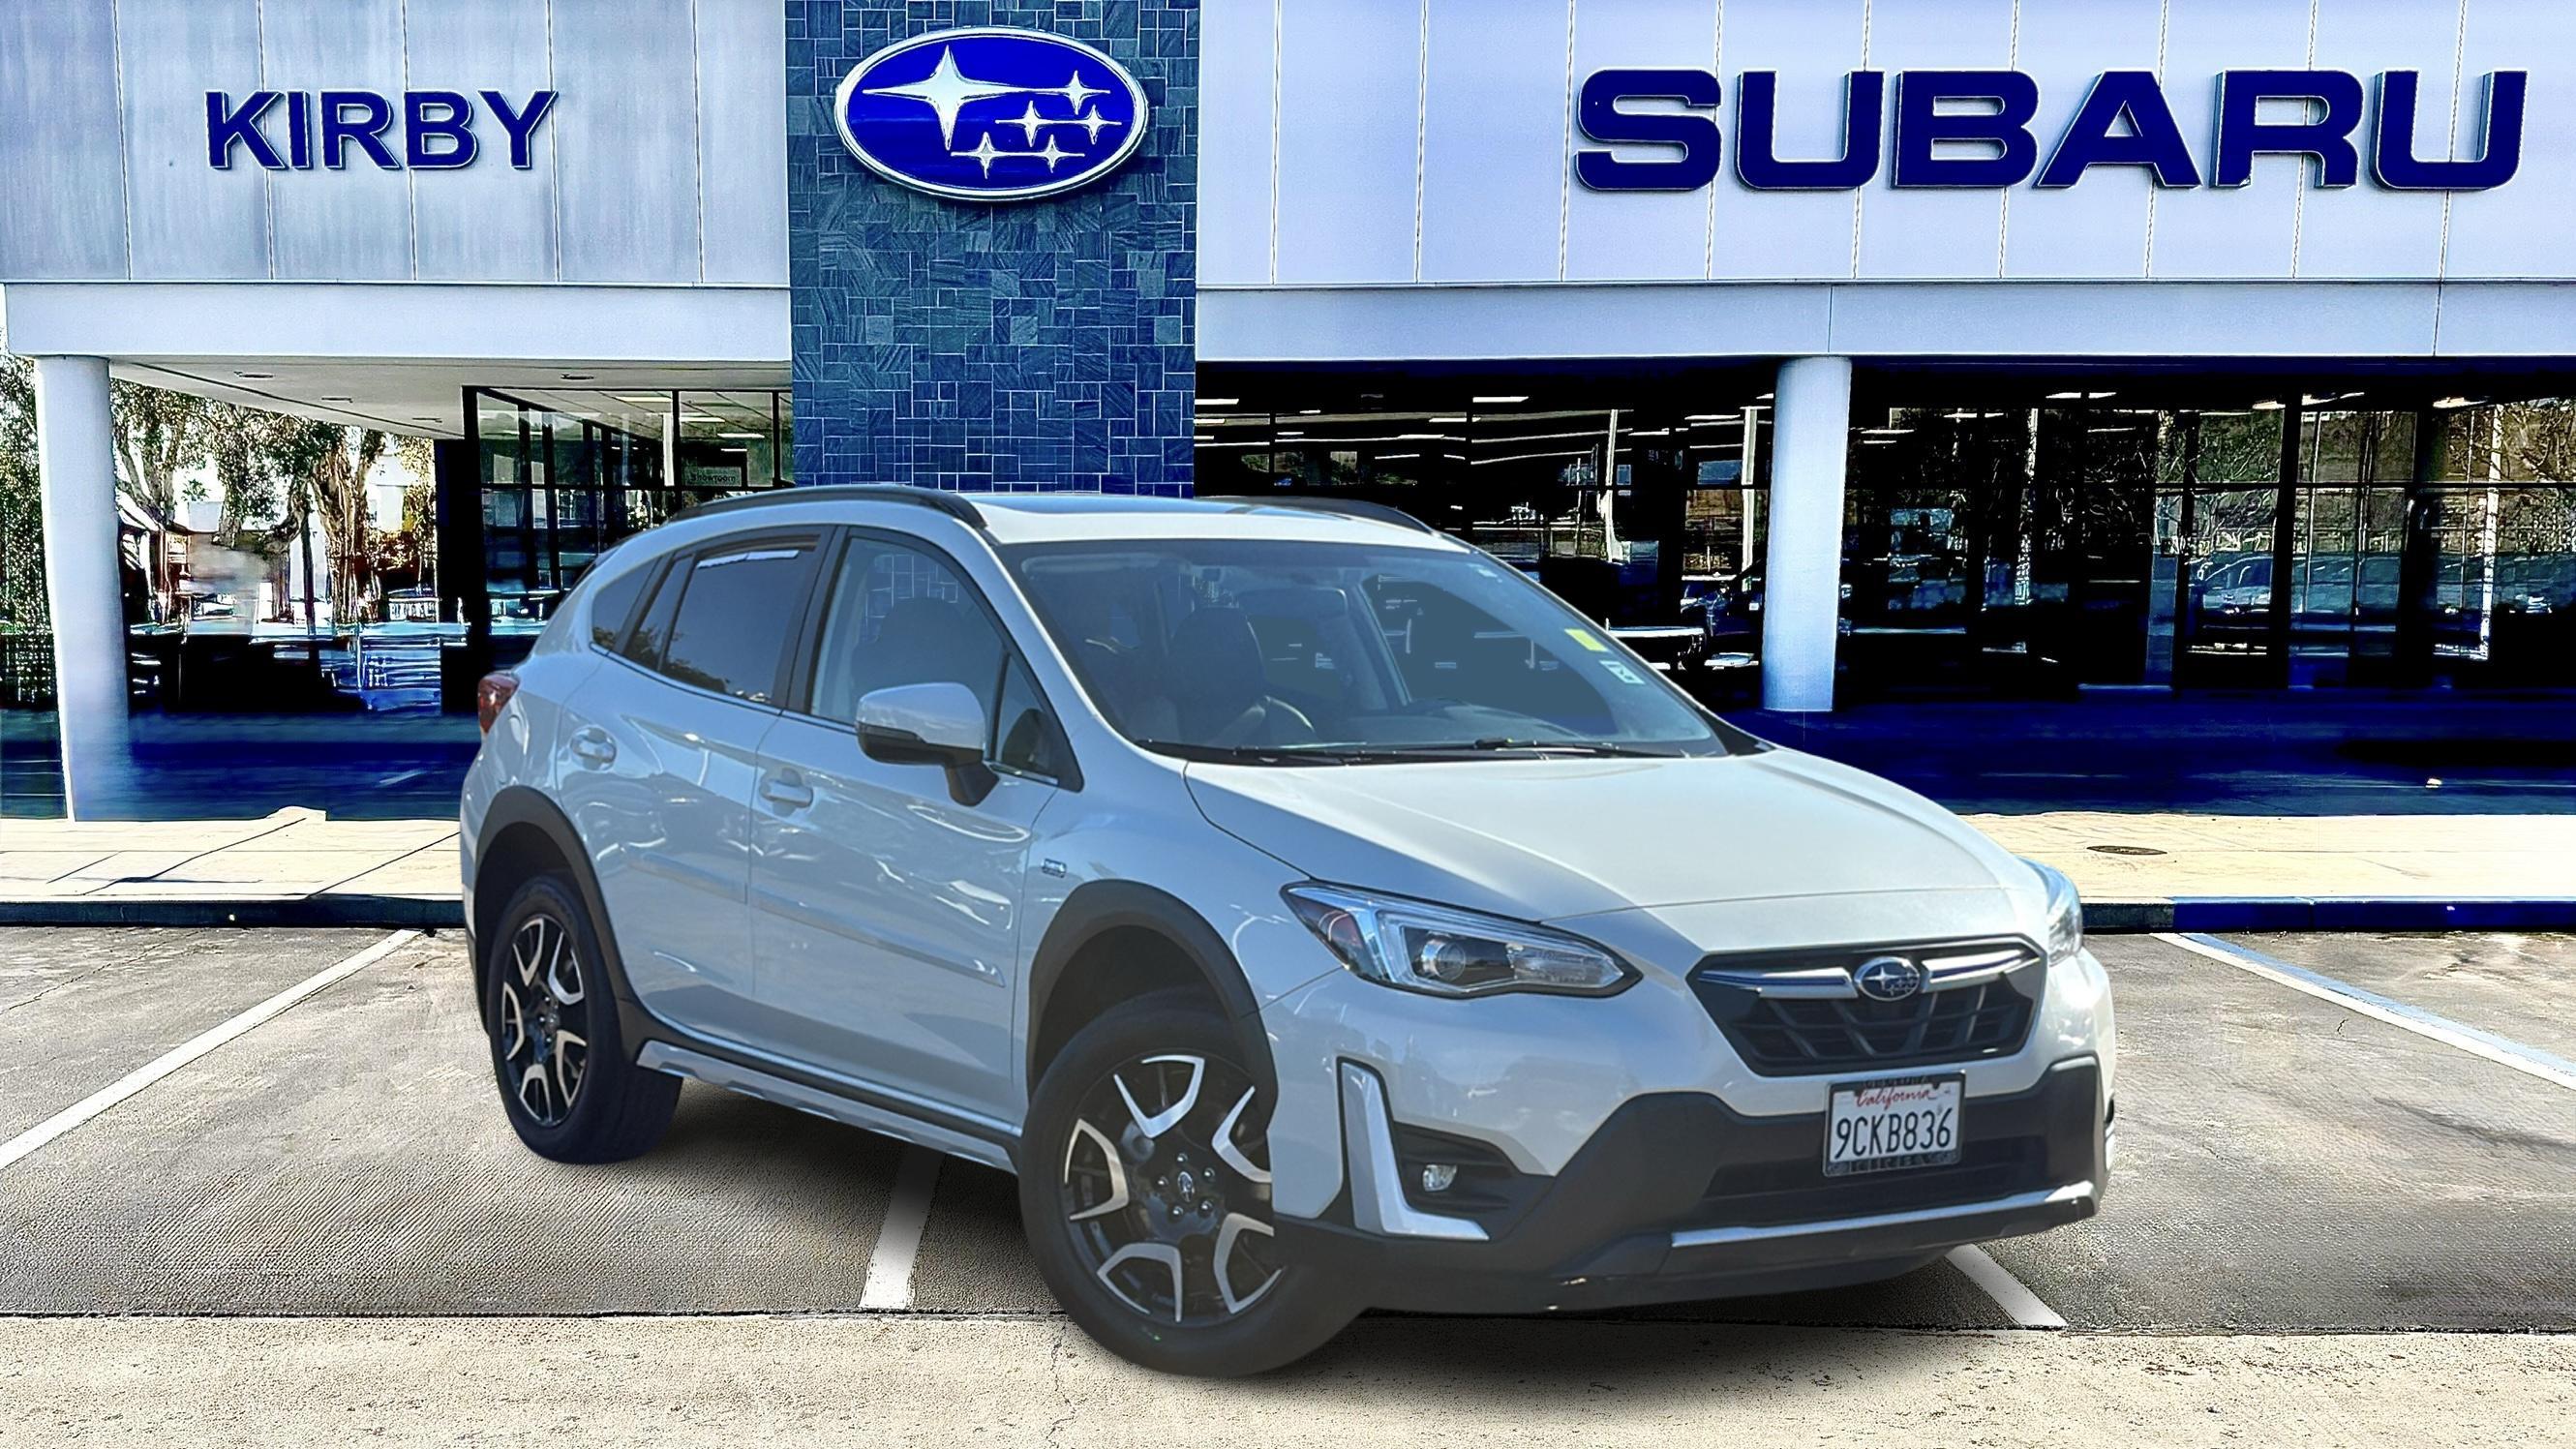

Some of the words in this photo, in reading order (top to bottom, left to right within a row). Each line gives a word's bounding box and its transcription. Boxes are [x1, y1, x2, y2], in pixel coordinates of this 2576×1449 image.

[206, 91, 559, 171] KIRBY
[1575, 70, 2526, 193] SUBARU
[1856, 1087, 1935, 1110] California
[1834, 1107, 1953, 1160] 9CKB836
